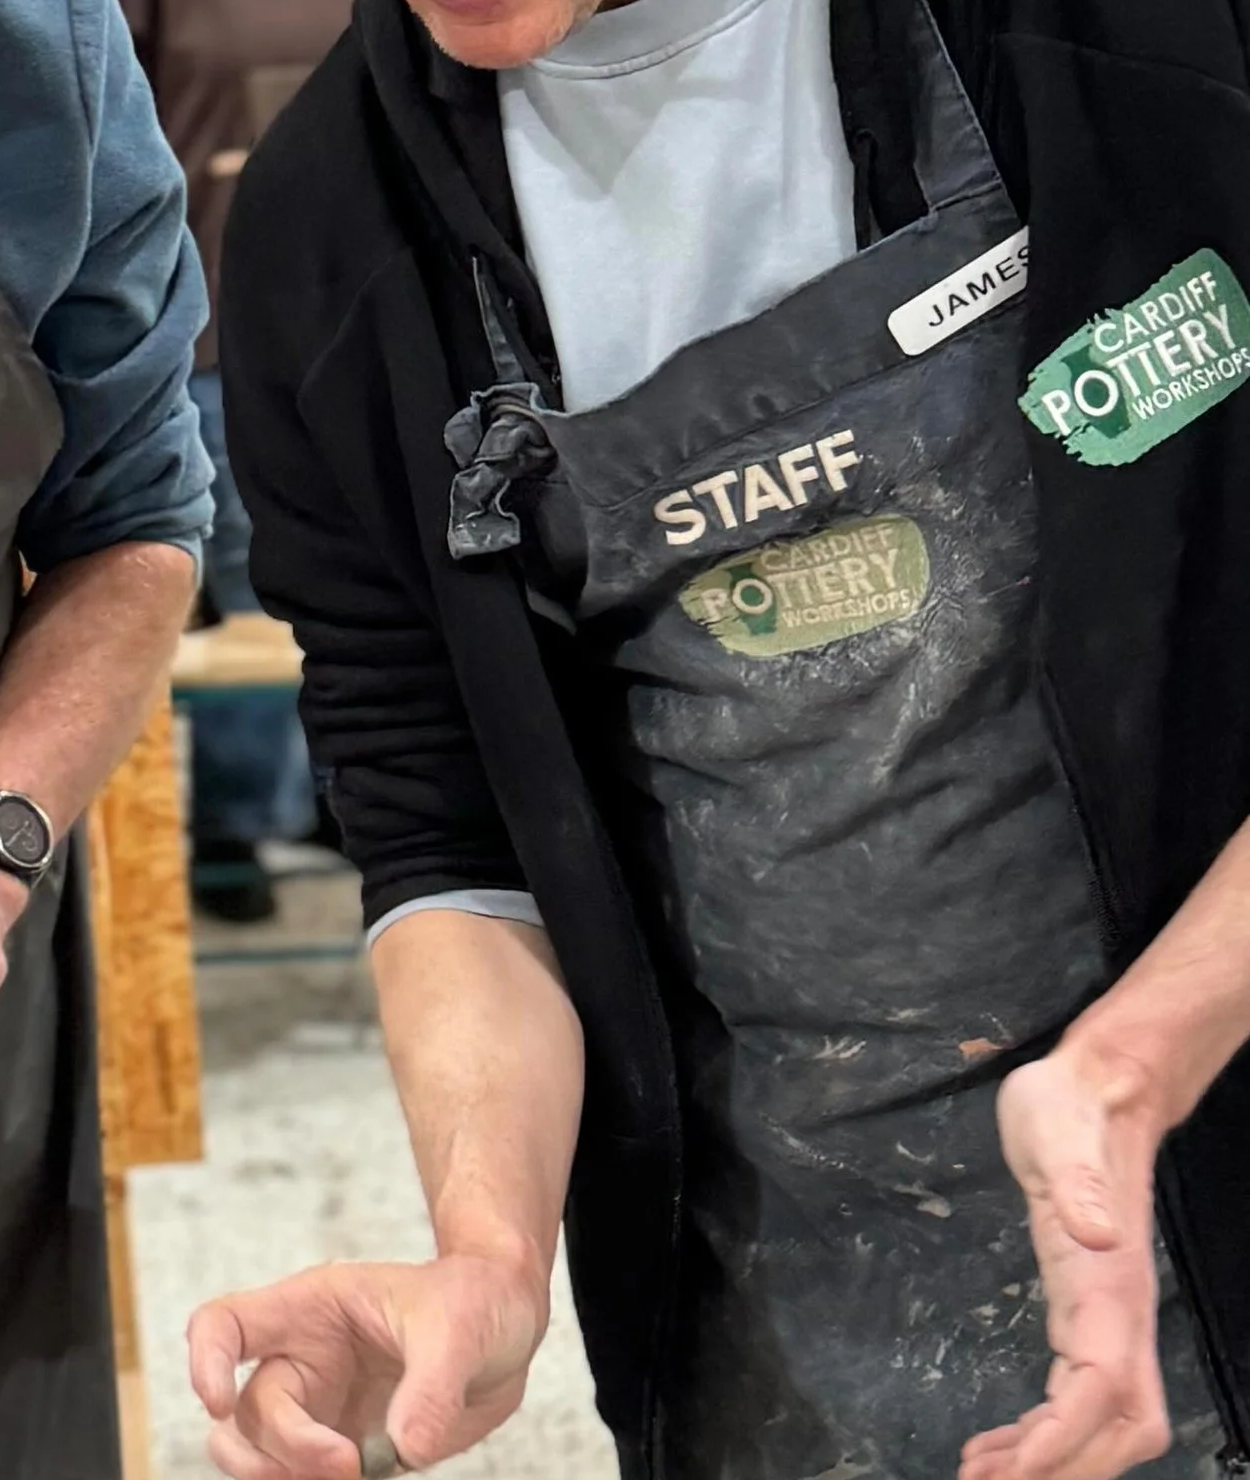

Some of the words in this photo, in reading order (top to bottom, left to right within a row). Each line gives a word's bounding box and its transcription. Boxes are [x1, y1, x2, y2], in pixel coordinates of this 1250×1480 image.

[928, 245, 1029, 327] JAMES
[1094, 271, 1218, 353] CARDIFF
[1041, 304, 1236, 436] POTTERY
[1132, 347, 1250, 420] WORKSHOPS
[653, 429, 860, 546] STAFF
[701, 548, 898, 621] POTTERY
[760, 523, 895, 570] CARDIFF
[782, 588, 913, 628] WORKSHOPS
